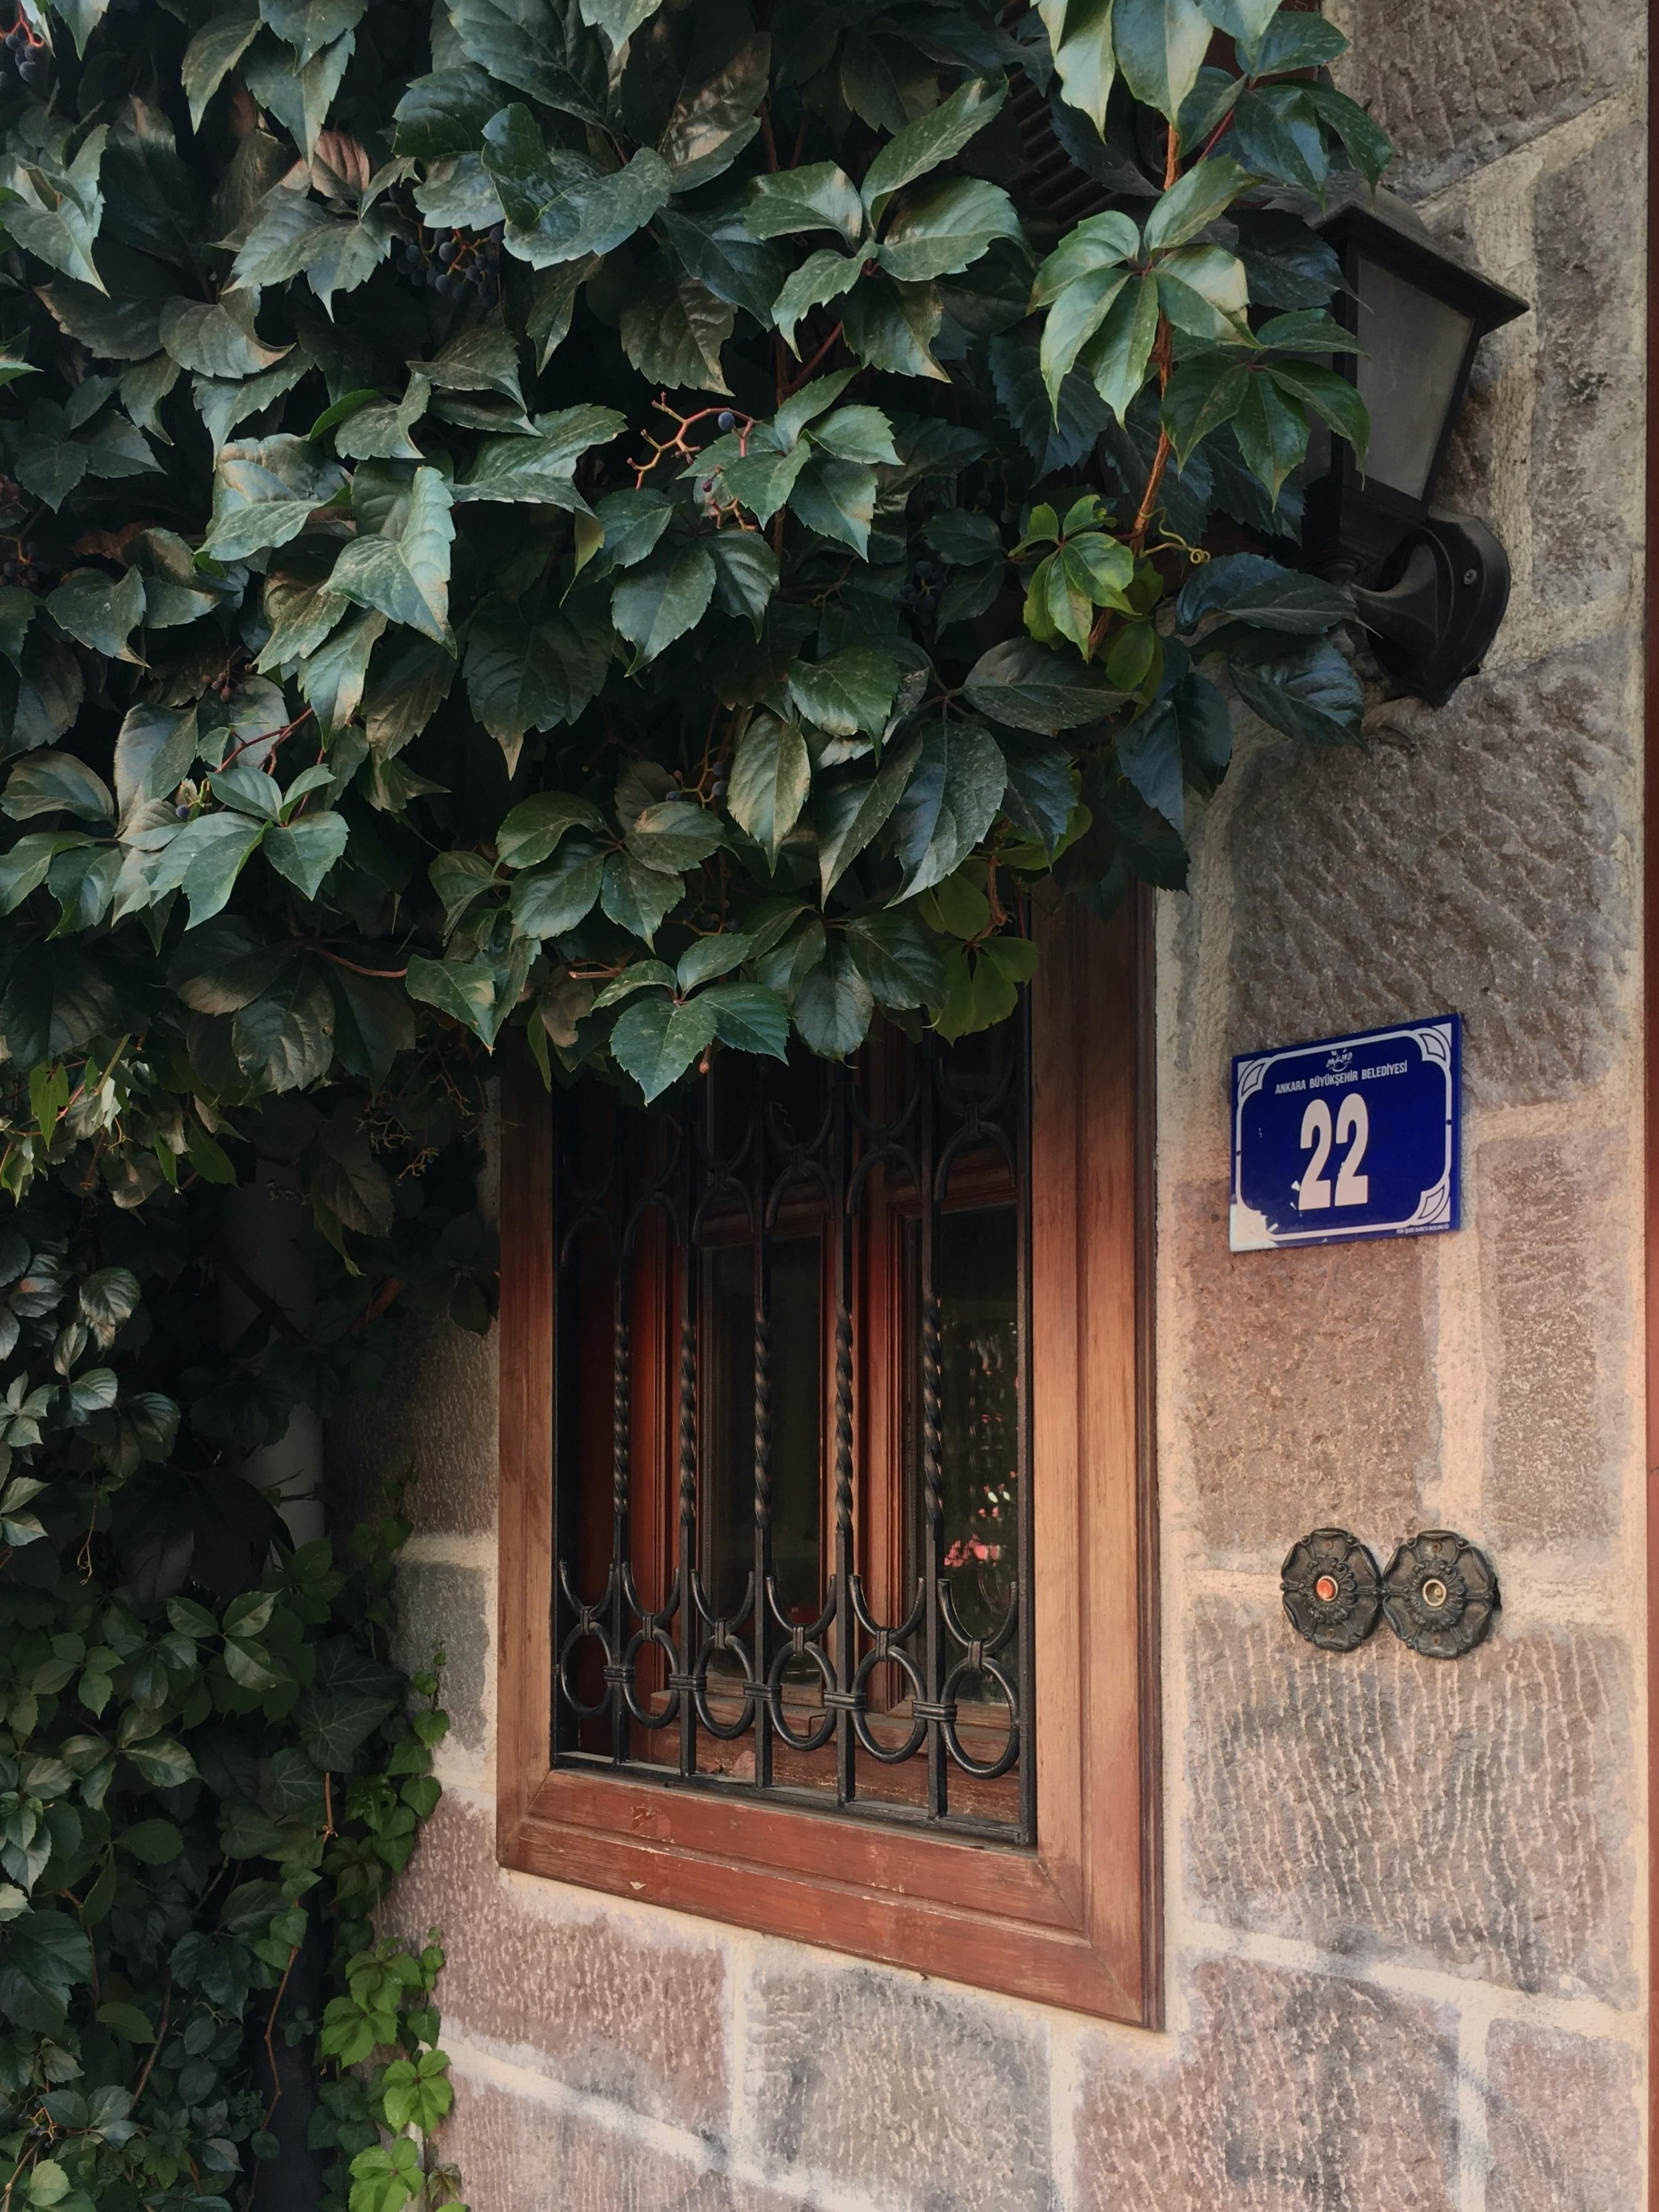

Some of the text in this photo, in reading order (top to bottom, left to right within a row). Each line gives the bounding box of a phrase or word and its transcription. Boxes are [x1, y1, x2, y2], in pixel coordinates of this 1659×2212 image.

[1275, 1060, 1407, 1095] ANKARA BÜYÜKŞEHİR BELEDİYESİ
[1298, 1093, 1368, 1210] 22
